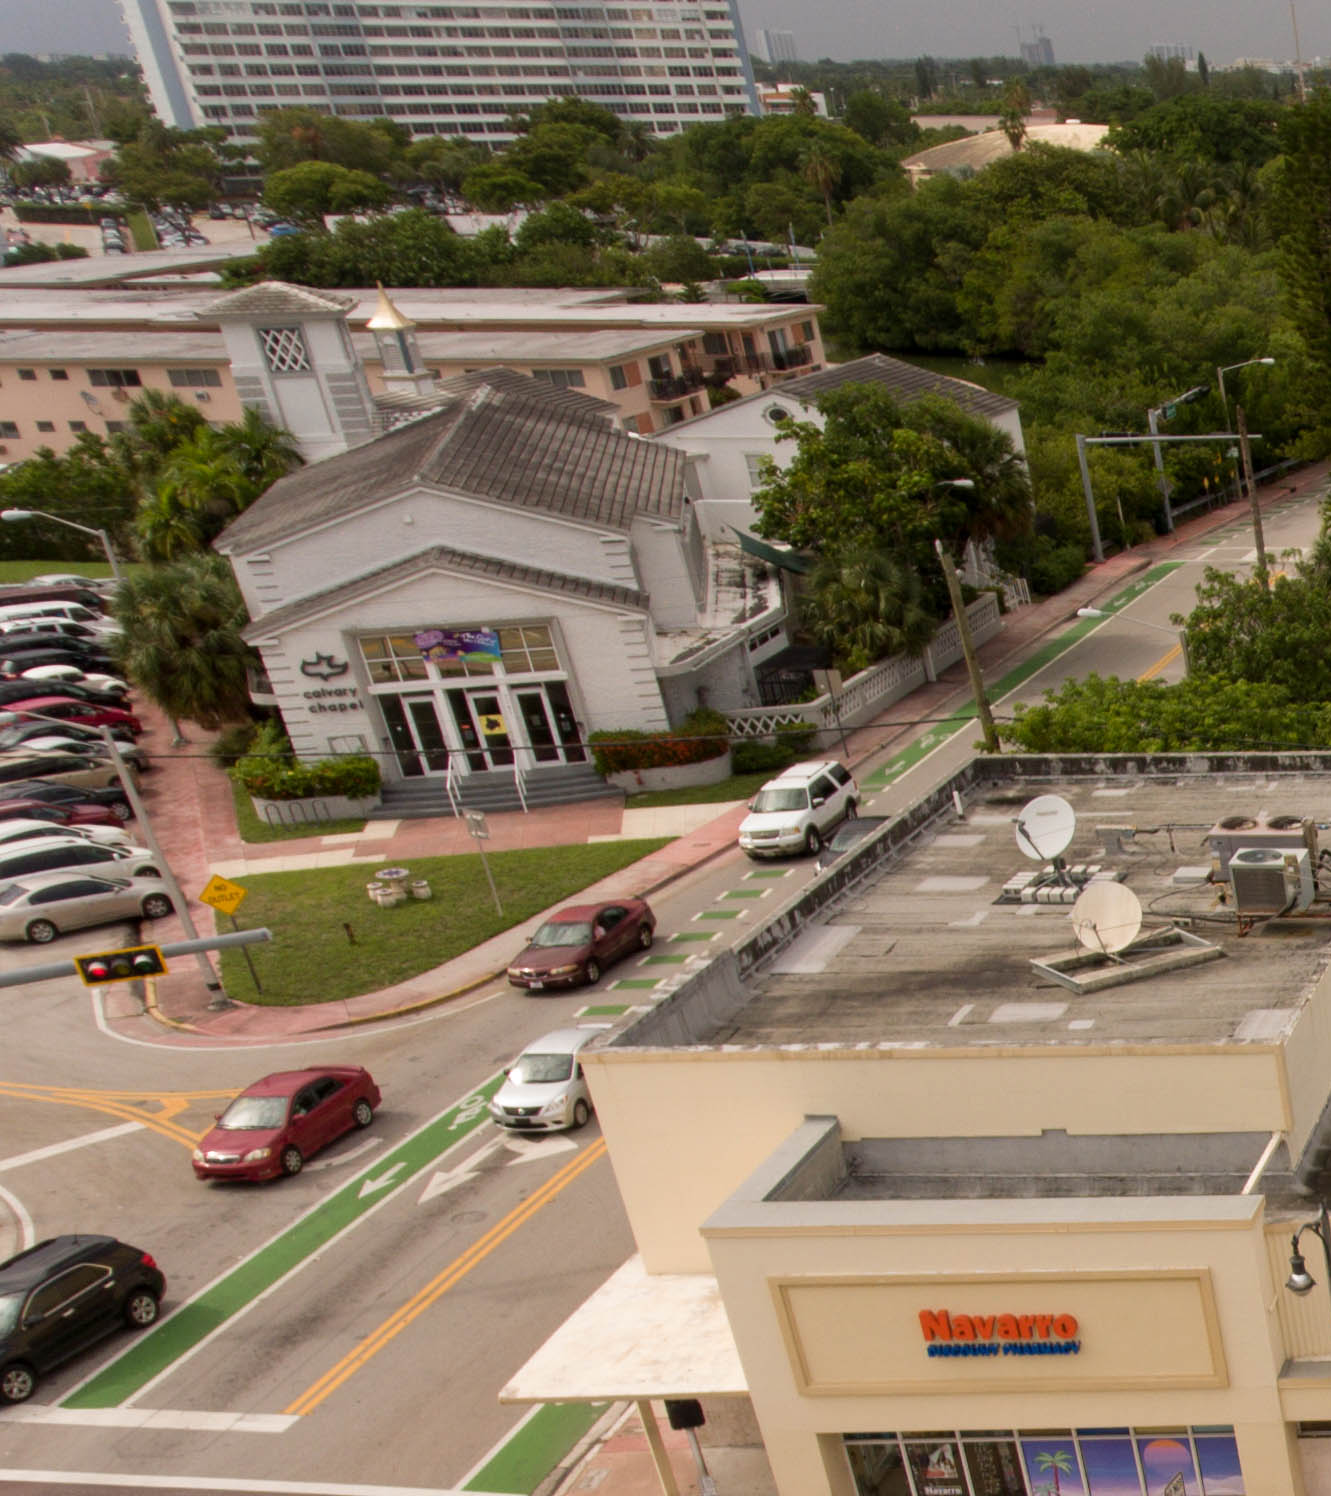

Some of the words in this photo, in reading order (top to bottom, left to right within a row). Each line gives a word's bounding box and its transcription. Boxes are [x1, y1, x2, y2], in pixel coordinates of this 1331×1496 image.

[303, 687, 357, 699] calvary
[308, 700, 364, 713] chapel
[919, 1309, 1078, 1341] Navarro
[927, 1343, 1000, 1358] DISCOUNT
[1002, 1340, 1081, 1356] PHARMACY
